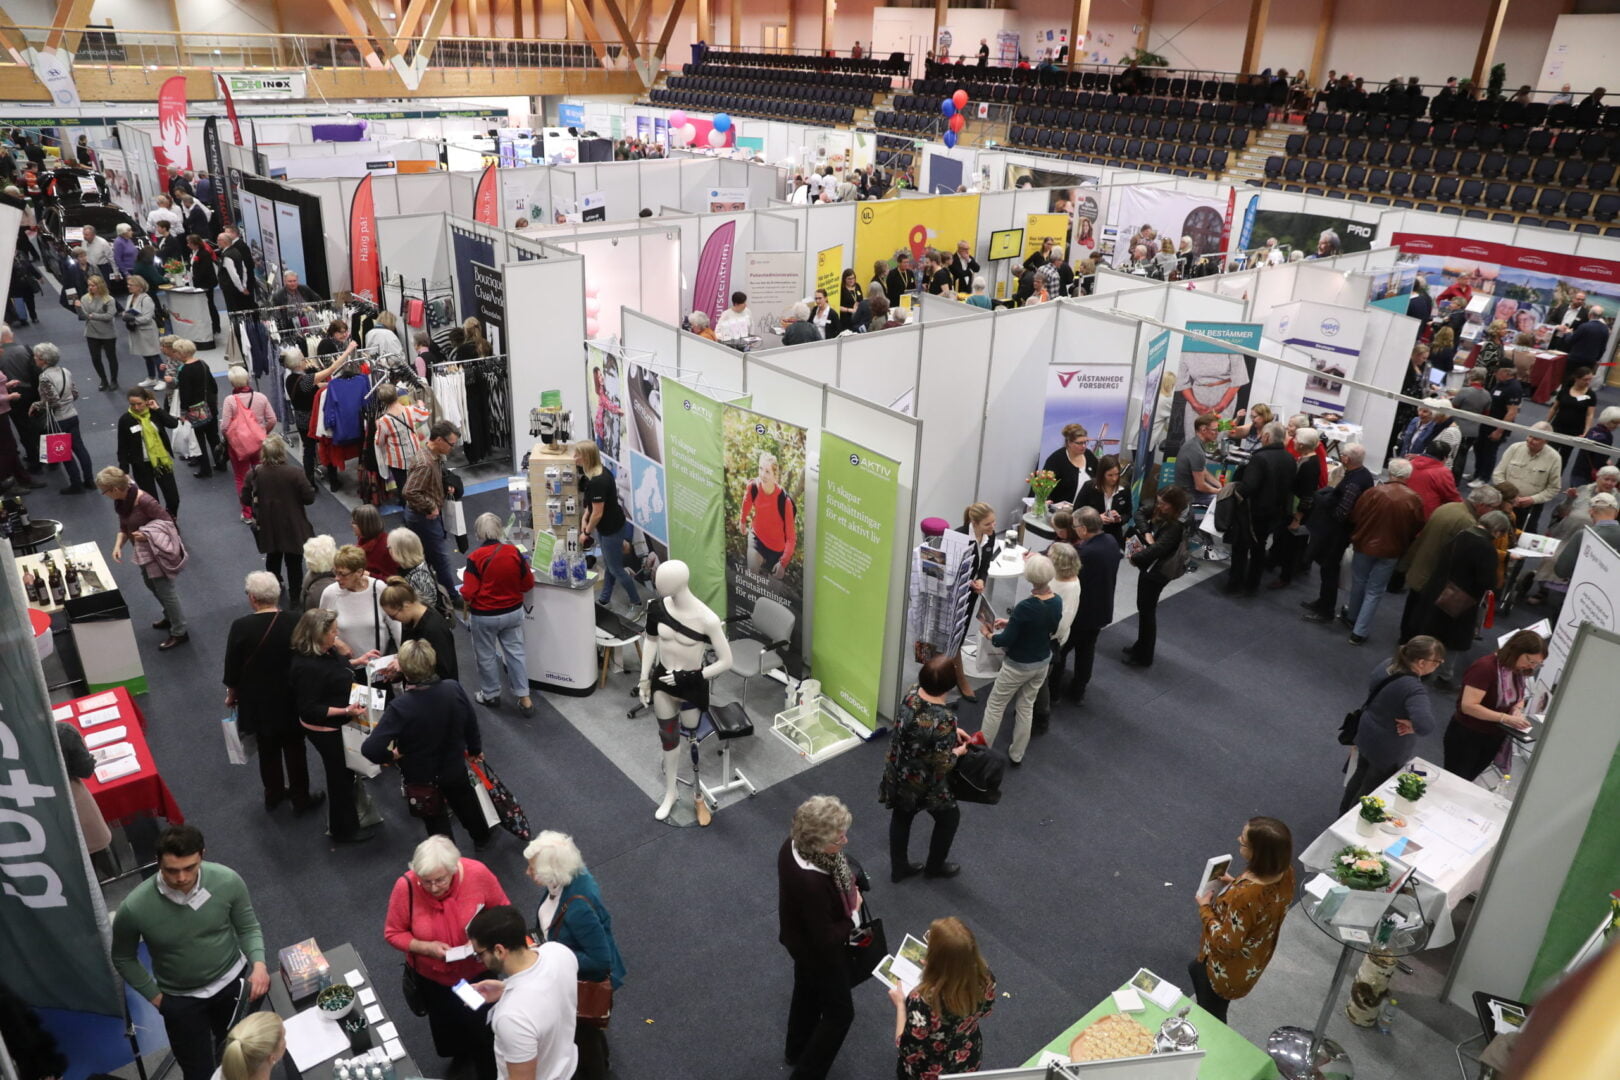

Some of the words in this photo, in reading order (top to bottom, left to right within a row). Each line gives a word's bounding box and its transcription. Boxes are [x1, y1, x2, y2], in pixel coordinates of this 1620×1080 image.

[1346, 223, 1372, 238] PRO
[360, 236, 370, 262] Häng
[1207, 328, 1254, 338] BESTÄMMER
[1077, 374, 1124, 383] VÄSTANHEDE
[860, 458, 891, 477] AKTIV
[827, 480, 836, 492] Vi
[836, 486, 861, 504] skapar
[826, 494, 882, 530] förutsättningar
[825, 507, 837, 521] för
[837, 516, 848, 528] ett
[847, 520, 870, 540] aktivt
[870, 530, 881, 544] liv
[734, 562, 744, 574] Vi
[744, 568, 770, 585] skapar
[735, 574, 792, 607] förutsättningar
[735, 586, 747, 597] för
